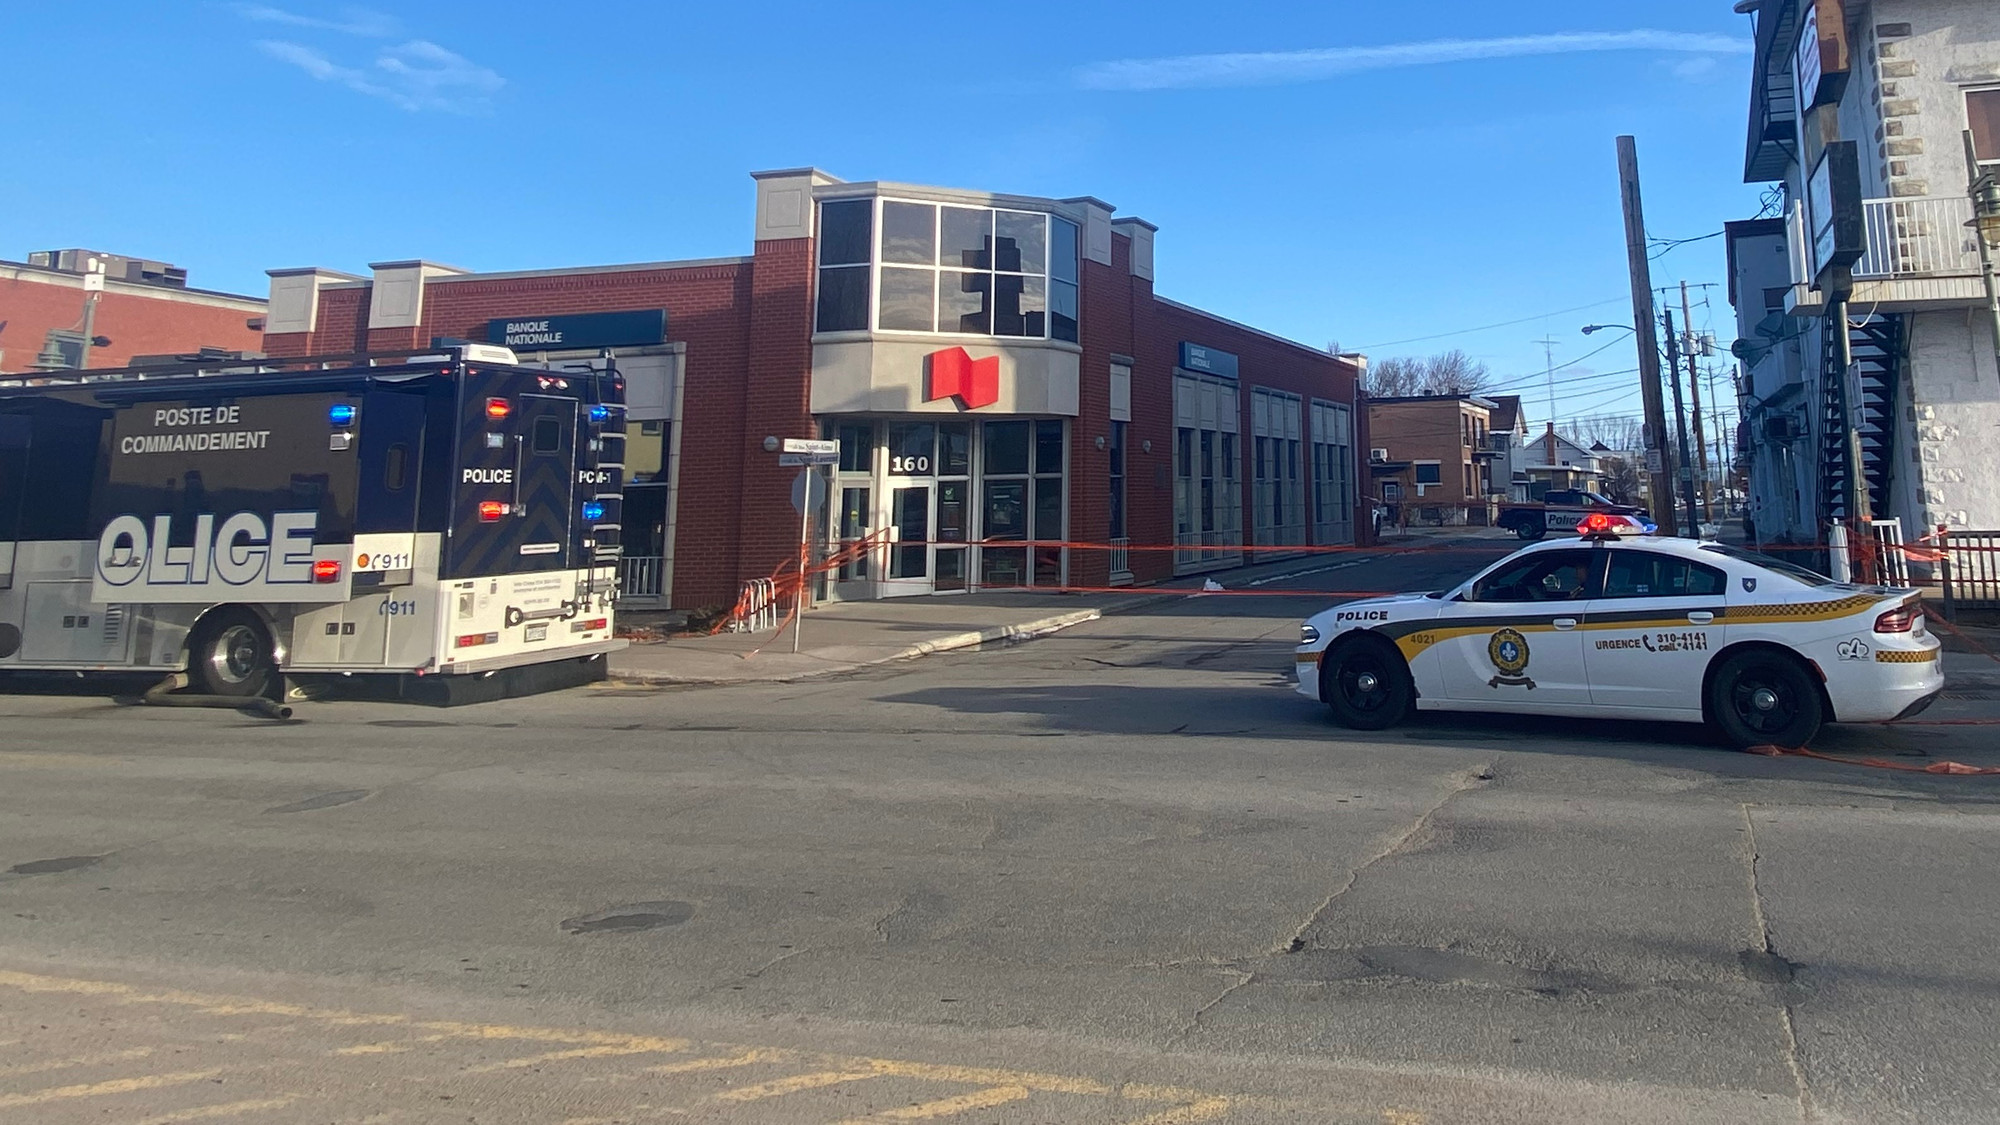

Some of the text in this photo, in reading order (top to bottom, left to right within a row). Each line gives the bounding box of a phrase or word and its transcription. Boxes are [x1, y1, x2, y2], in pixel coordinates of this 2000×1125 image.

[506, 321, 549, 334] BANQUE
[505, 332, 563, 345] NATIONALE
[154, 405, 240, 427] POSTE DE
[121, 430, 270, 454] COMMANDEMENT
[892, 456, 929, 472] 160
[462, 469, 512, 484] POLICE
[382, 553, 409, 569] 911
[389, 601, 416, 615] 911
[1336, 610, 1388, 622] POLICE
[1410, 634, 1436, 644] 4021
[1595, 638, 1642, 650] URGENCE
[1656, 632, 1708, 643] 310-4141
